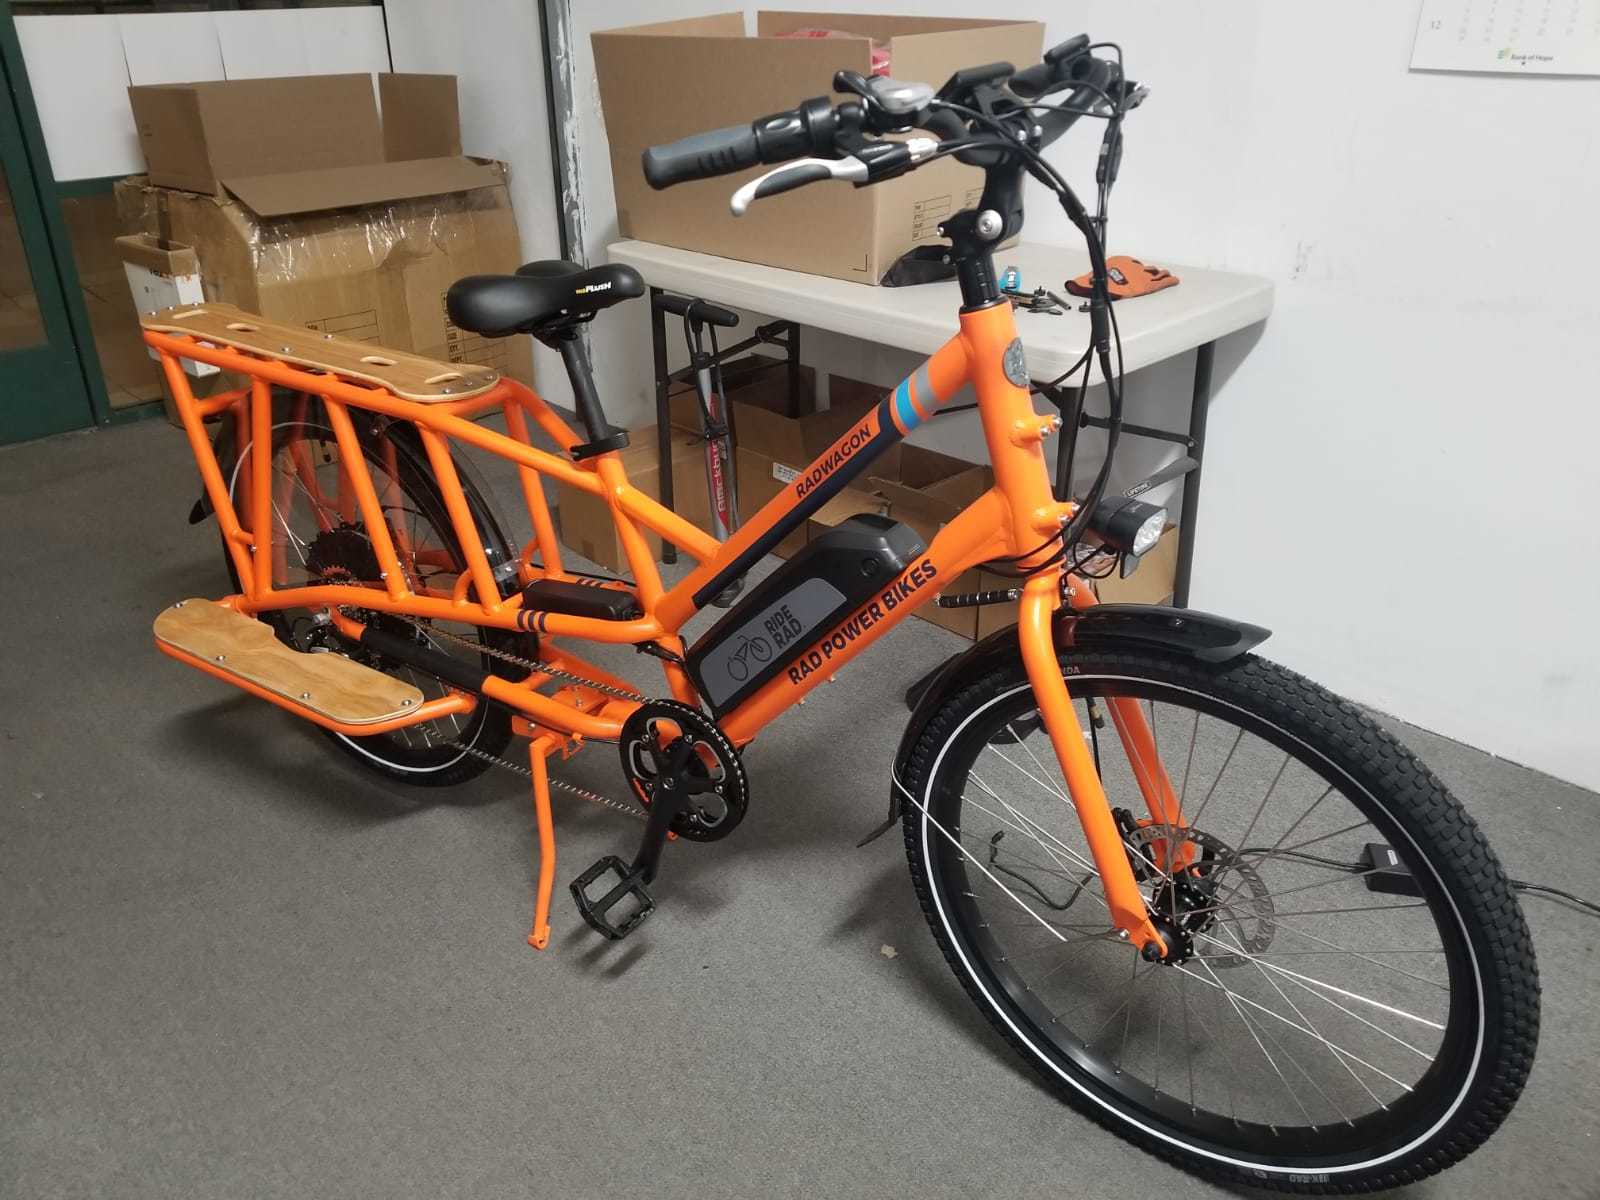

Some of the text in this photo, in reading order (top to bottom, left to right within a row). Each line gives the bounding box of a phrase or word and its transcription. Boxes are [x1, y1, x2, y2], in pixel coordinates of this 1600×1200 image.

[796, 424, 872, 498] RADWAGON
[764, 604, 793, 633] RIDE
[788, 558, 938, 685] RAD POWER BIKES
